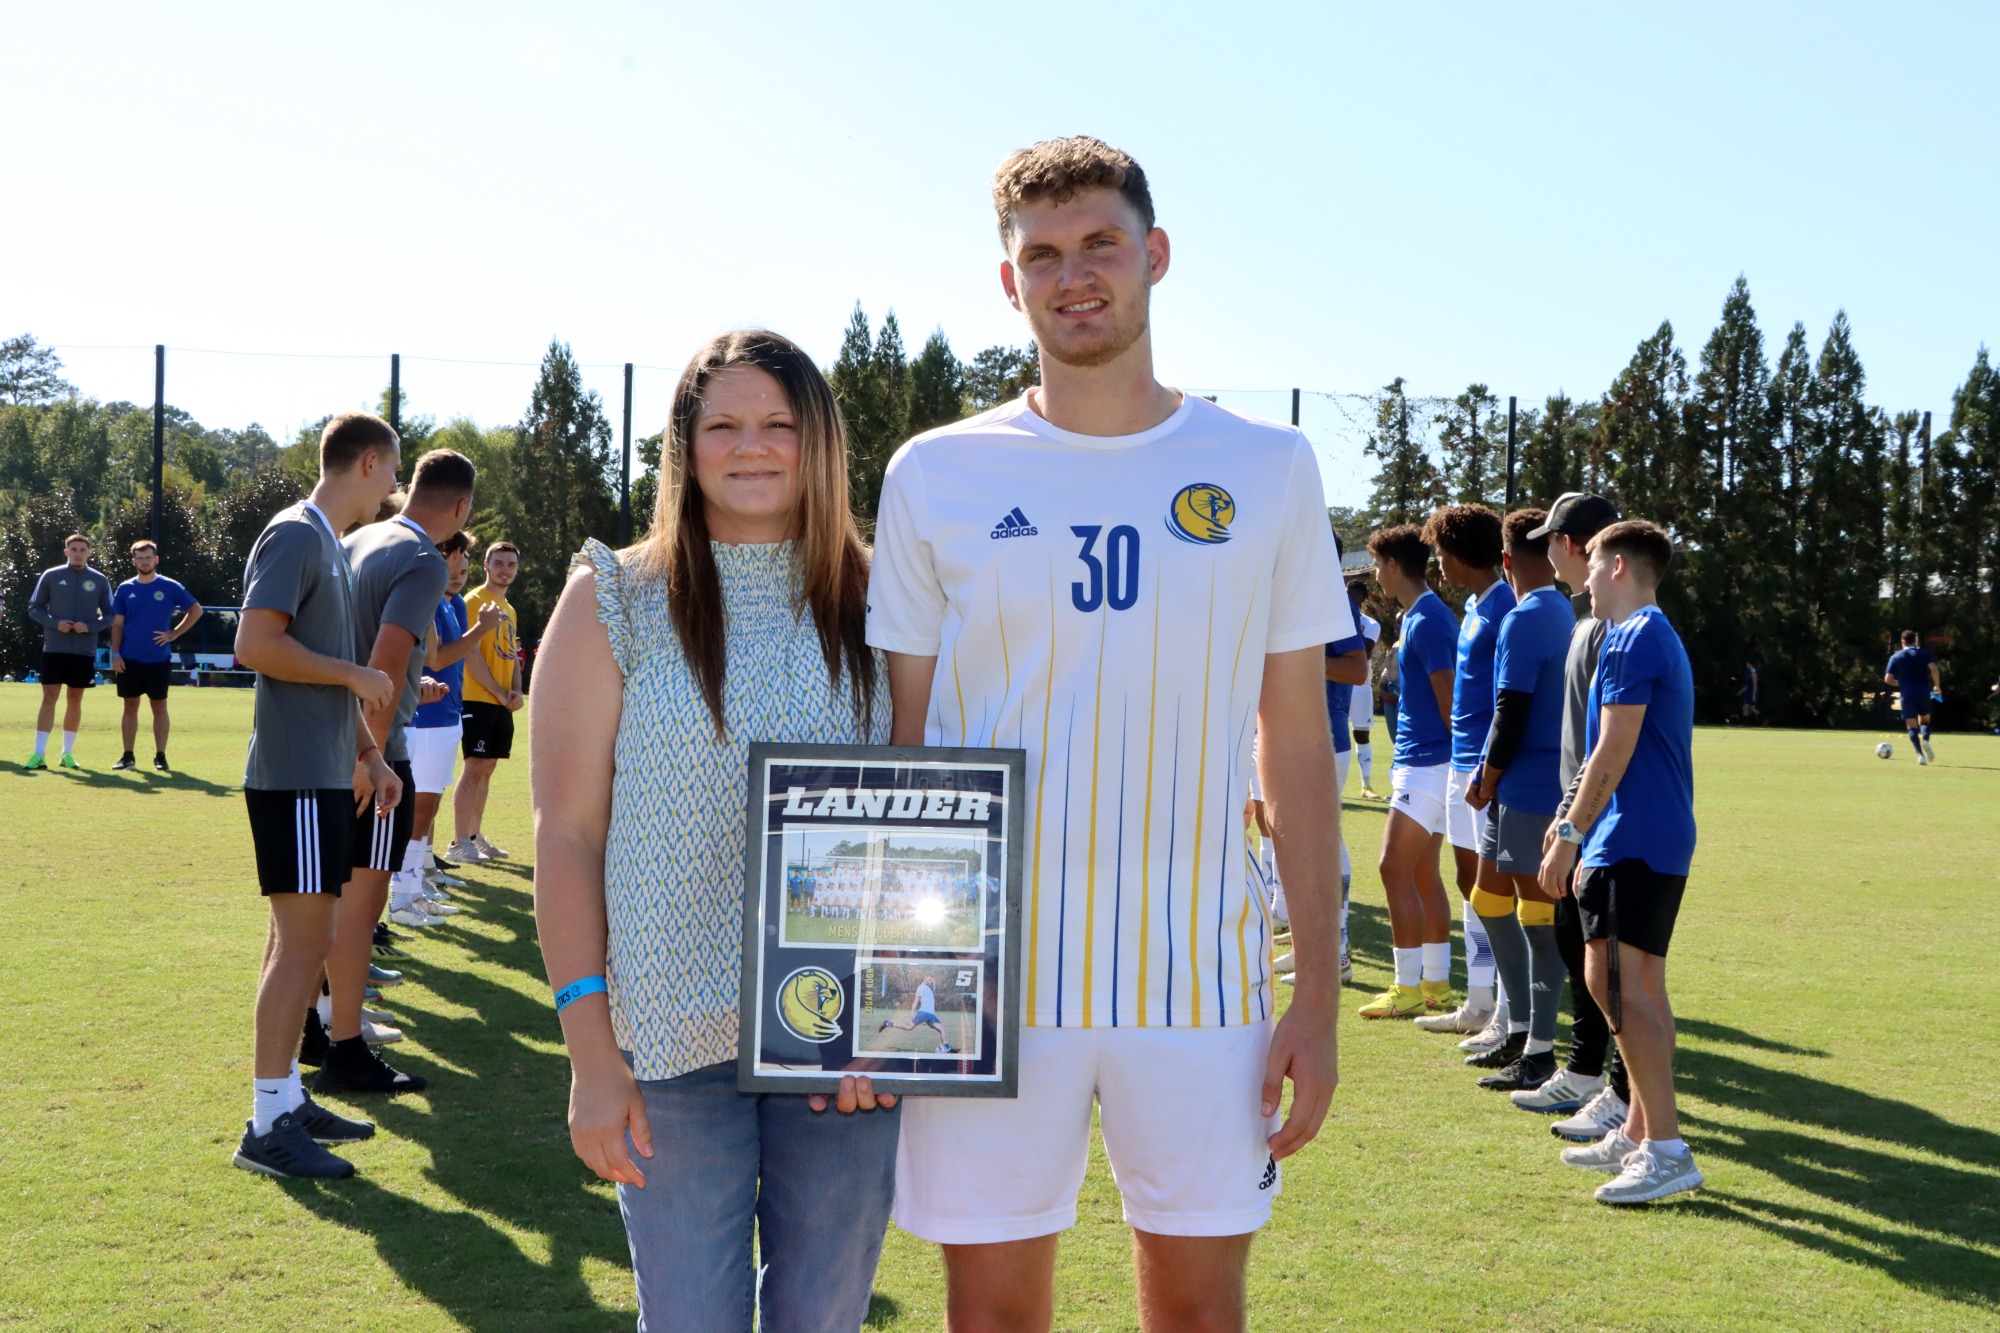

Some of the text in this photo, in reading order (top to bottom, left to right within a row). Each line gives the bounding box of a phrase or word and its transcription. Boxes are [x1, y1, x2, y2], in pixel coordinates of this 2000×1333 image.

[990, 525, 1039, 540] adidas
[1069, 524, 1141, 613] 30
[782, 786, 992, 821] LANDER
[828, 925, 858, 938] MENS
[862, 926, 904, 939] SOCCER
[865, 968, 875, 1015] LOGAN KOON
